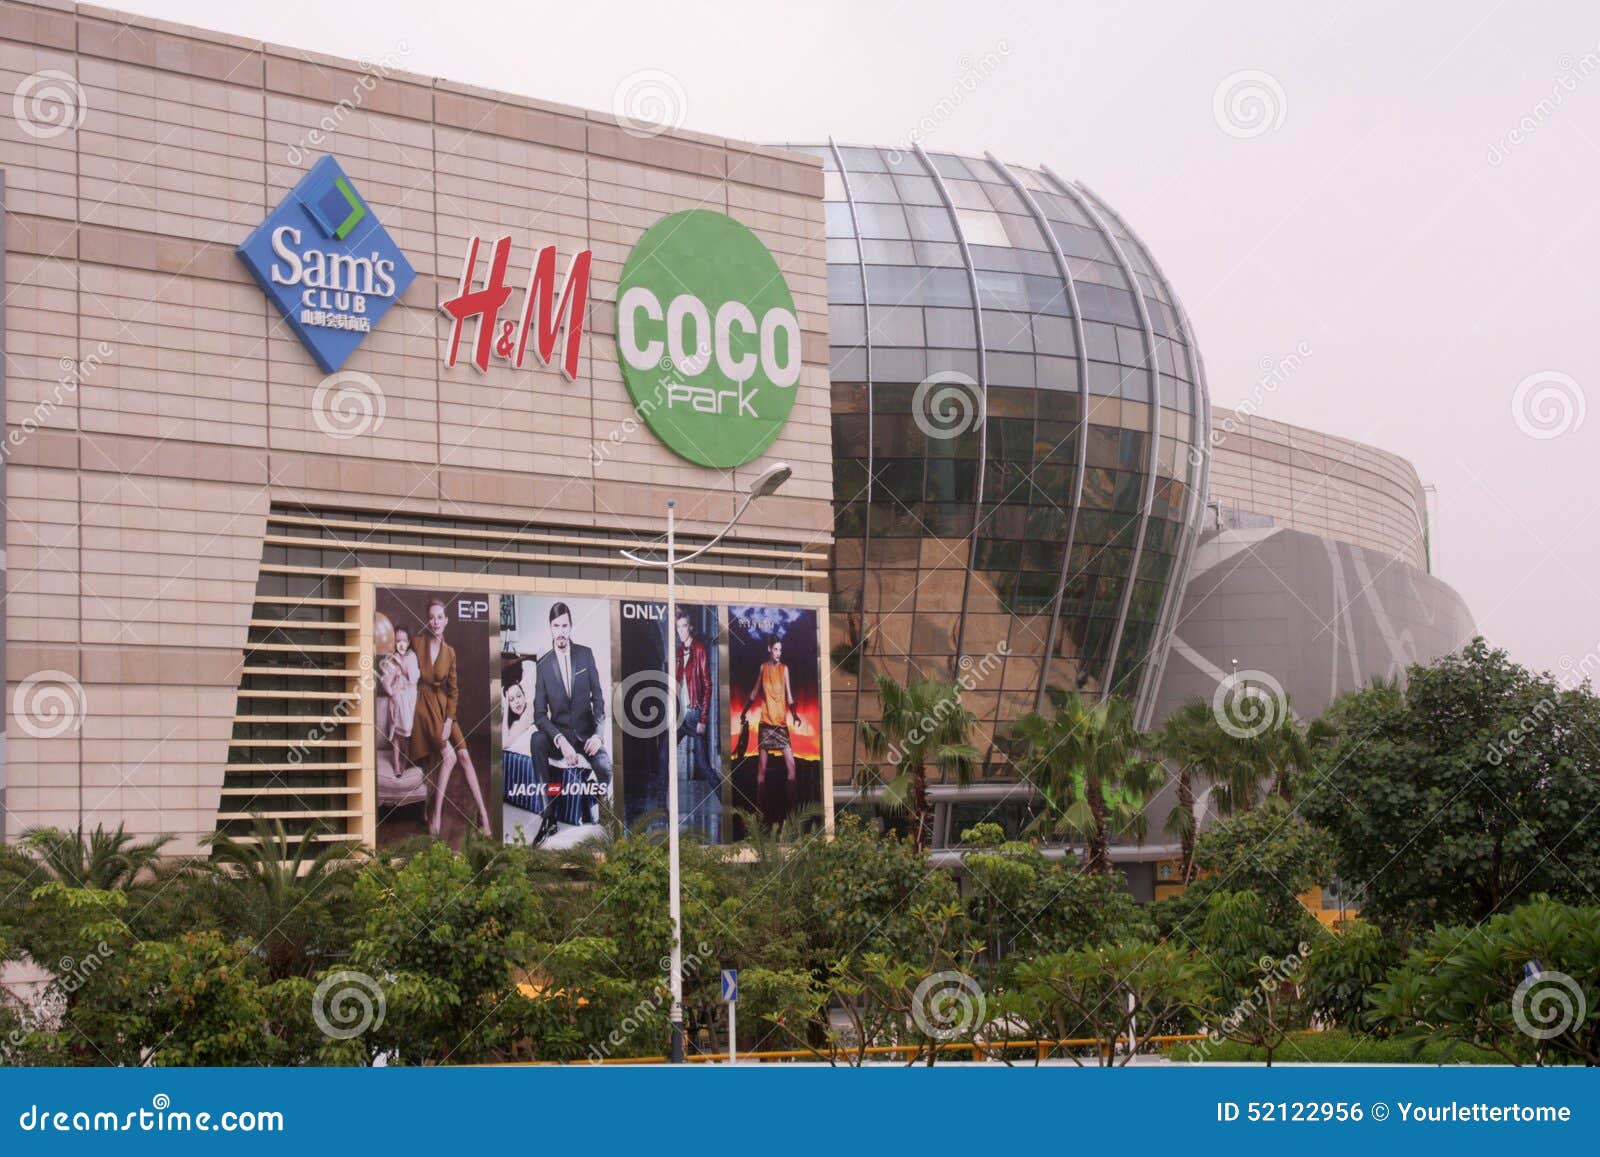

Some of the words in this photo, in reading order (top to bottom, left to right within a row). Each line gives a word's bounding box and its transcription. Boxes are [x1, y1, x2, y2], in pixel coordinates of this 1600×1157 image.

[271, 226, 396, 297] Sam's
[302, 288, 366, 314] CLUB
[439, 235, 593, 384] H&M
[618, 286, 802, 388] COCO
[623, 603, 667, 620] ONLY
[508, 783, 547, 797] JACK
[561, 782, 608, 796] JONES
